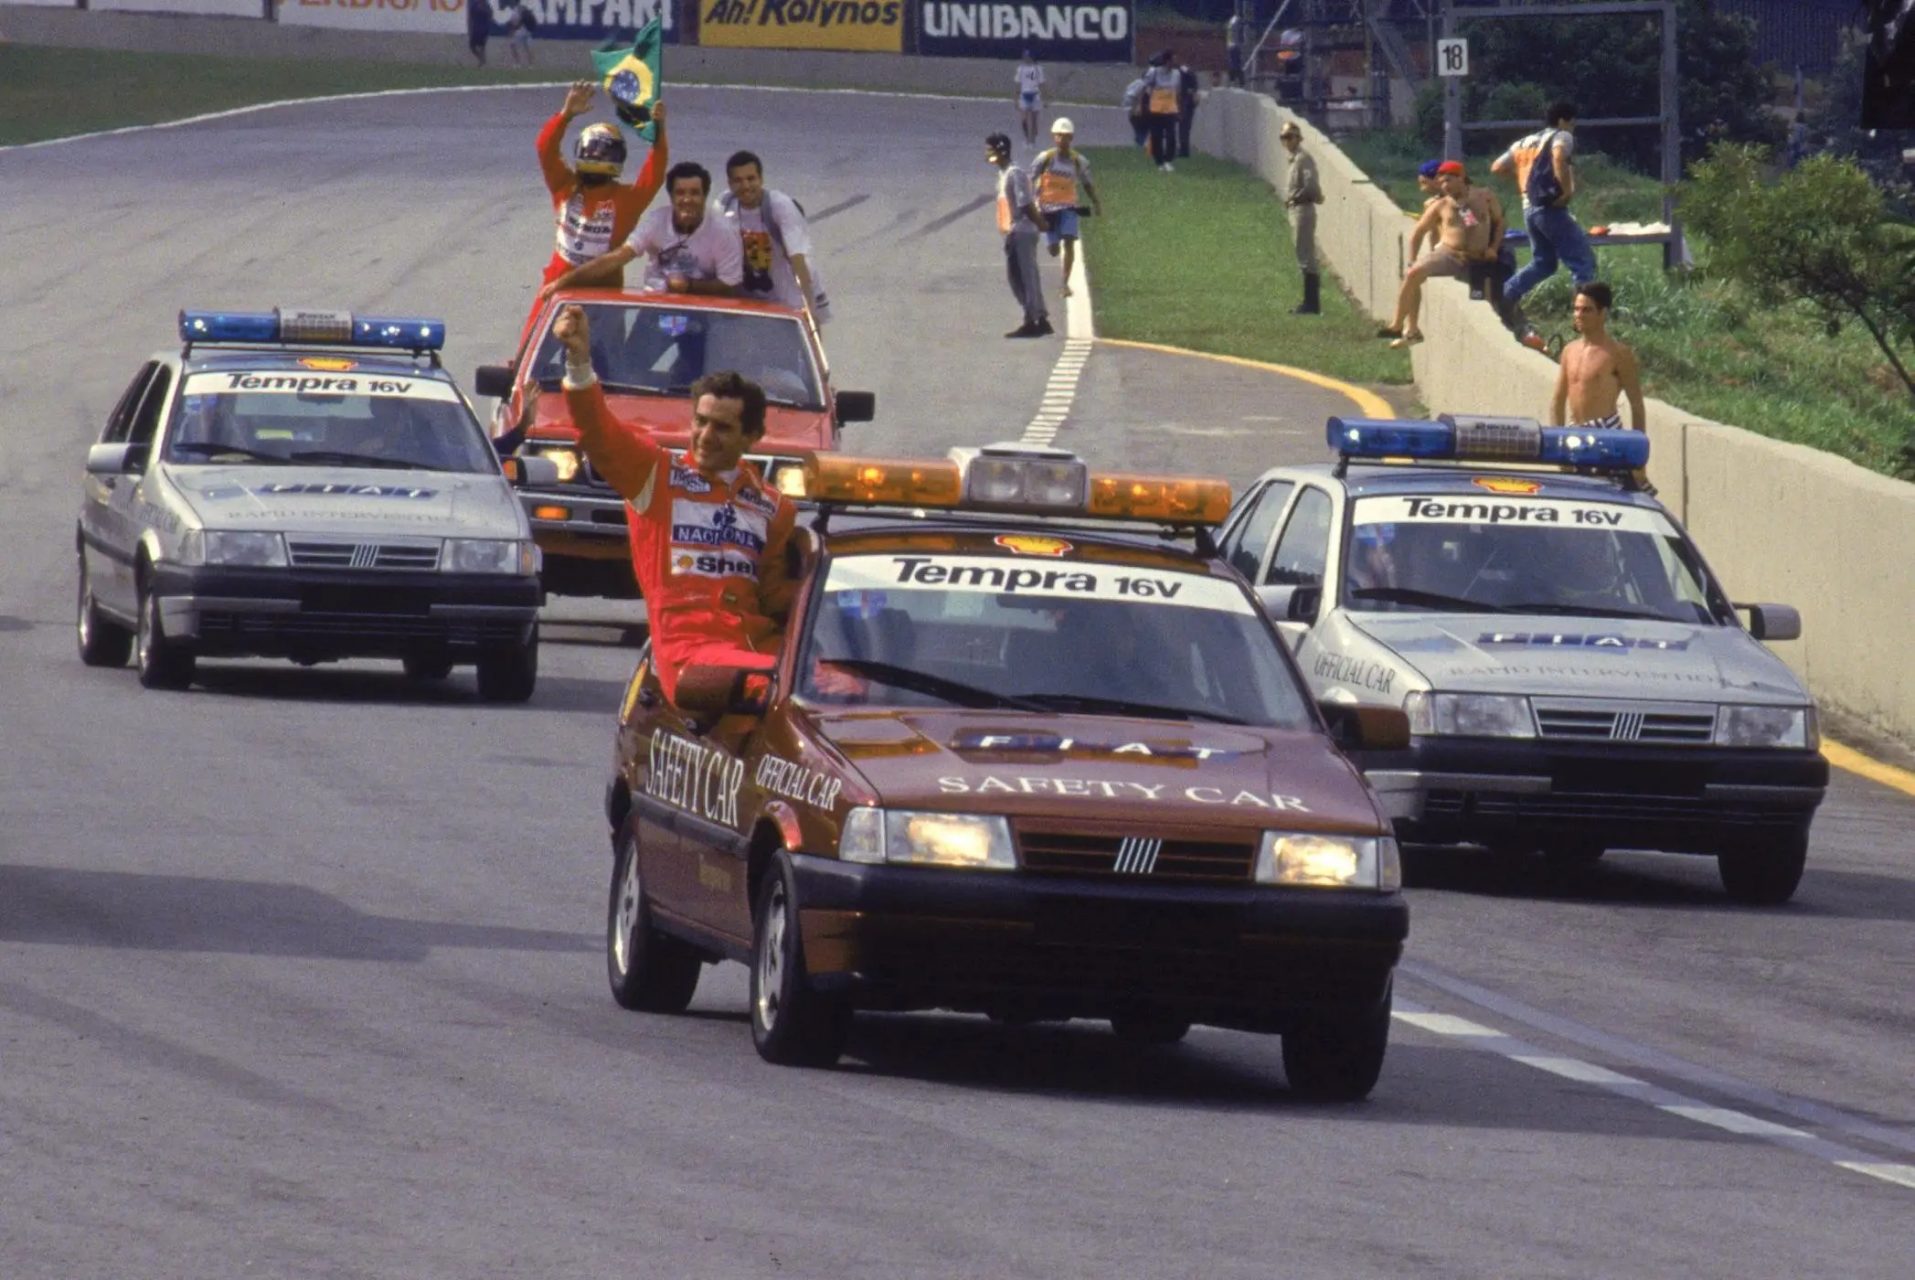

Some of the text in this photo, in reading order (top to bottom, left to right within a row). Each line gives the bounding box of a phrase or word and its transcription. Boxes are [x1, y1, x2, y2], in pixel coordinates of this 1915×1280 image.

[757, 0, 900, 27] Kolynos
[923, 2, 1128, 40] UNIBANCO
[1442, 44, 1463, 70] 18
[227, 373, 412, 393] Tempra 16V
[1403, 498, 1624, 526] Tempra 16V
[893, 558, 1182, 598] Tempra 16V
[1314, 653, 1396, 694] OFFICIAL CAR
[979, 735, 1226, 760] FIAT
[645, 728, 745, 828] SAFETY CAR
[756, 754, 842, 812] OFFICIAL CAR
[937, 775, 1314, 813] SAFETY CAR
